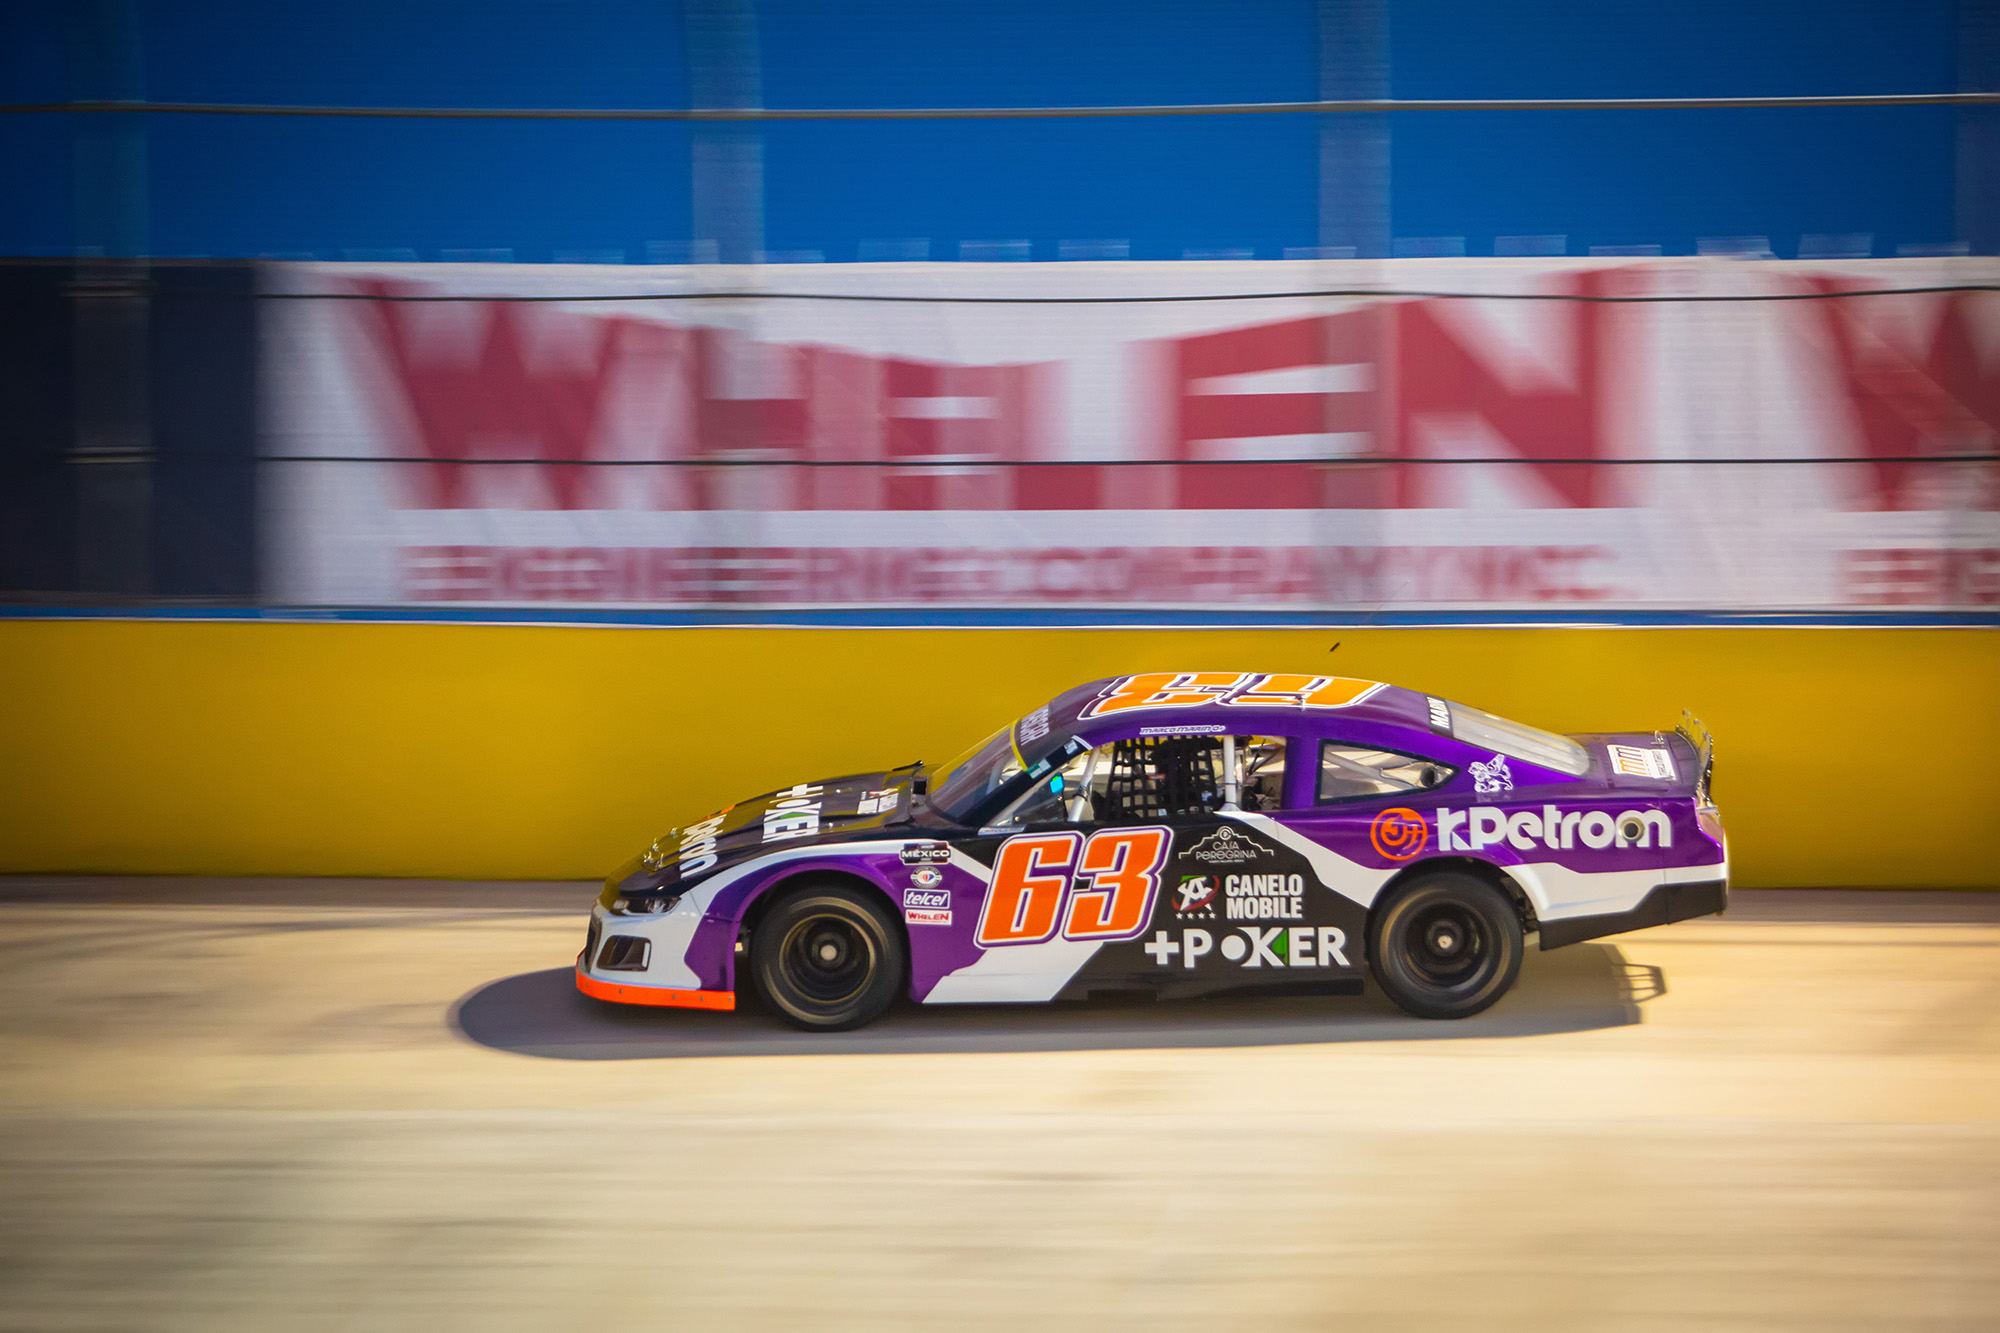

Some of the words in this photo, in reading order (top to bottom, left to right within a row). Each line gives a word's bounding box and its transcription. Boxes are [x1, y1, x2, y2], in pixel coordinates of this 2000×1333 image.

[901, 848, 950, 858] MÉXICO
[1195, 850, 1257, 860] PEREGRINA
[974, 825, 1174, 950] 63
[1225, 874, 1303, 897] CANELO
[906, 892, 948, 906] telcel
[1226, 897, 1303, 919] MOBILE
[907, 911, 949, 921] WHELEN
